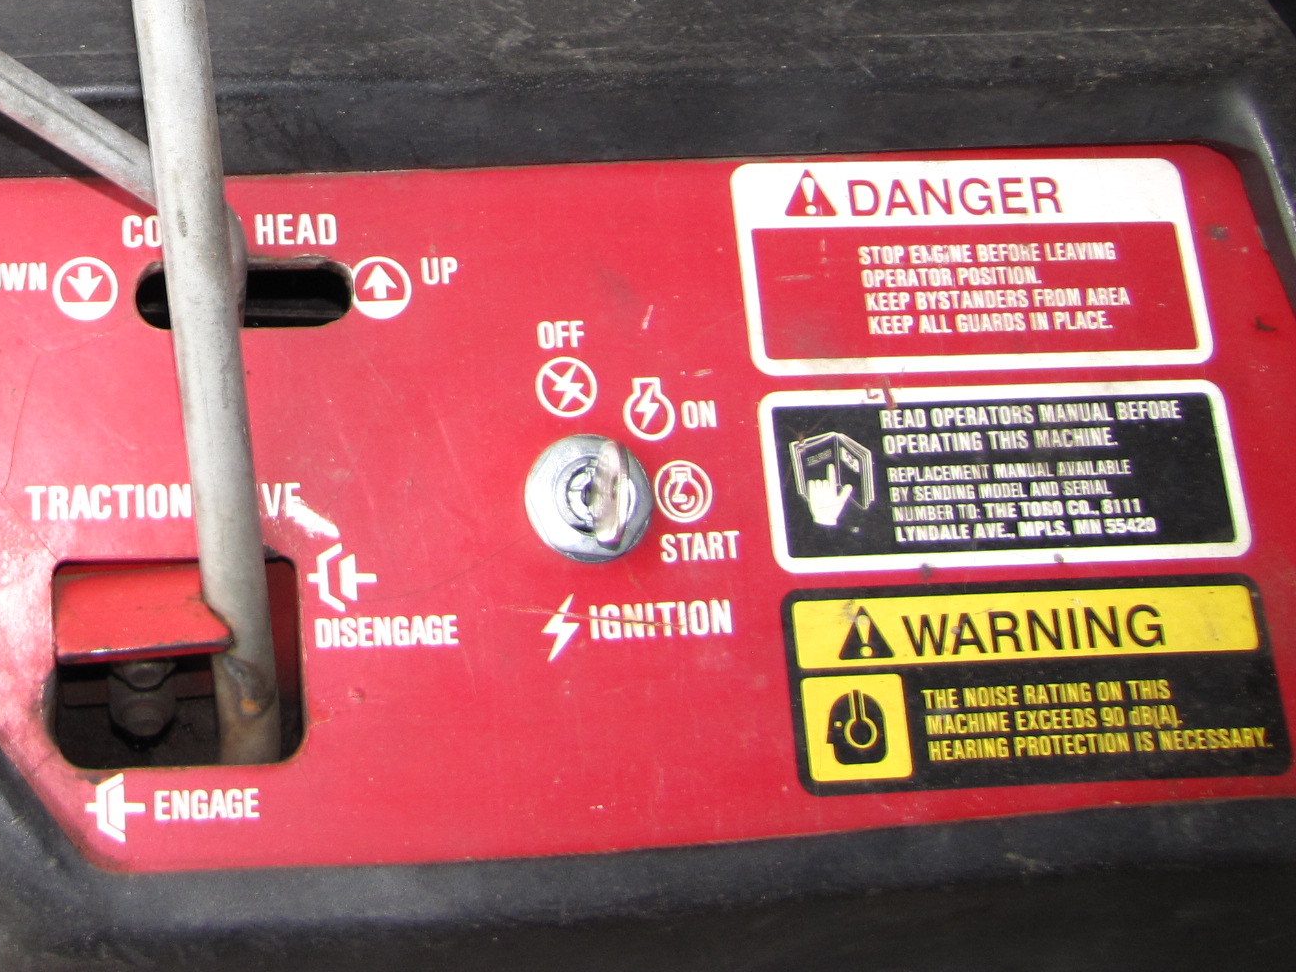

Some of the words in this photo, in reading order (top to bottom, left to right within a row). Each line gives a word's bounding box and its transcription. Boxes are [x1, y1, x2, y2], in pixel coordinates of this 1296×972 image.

[847, 176, 1064, 217] DANGER
[255, 213, 338, 245] HEAD
[857, 245, 904, 265] STOP
[908, 244, 973, 264] ENGINE
[976, 243, 1042, 263] BEFORE
[1044, 241, 1117, 261] LEAVING
[420, 256, 458, 286] UP
[861, 268, 953, 288] OPERATOR
[955, 266, 1042, 286] POSITION.
[864, 291, 910, 311] KEEP
[914, 289, 1029, 310] BYSTANDERS
[1032, 287, 1082, 307] FROM
[1085, 286, 1130, 306] AREA
[536, 320, 585, 349] OFF
[867, 315, 913, 335] KEEP
[918, 314, 953, 333] ALL
[955, 312, 1026, 332] GUARDS
[1028, 311, 1049, 331] IN
[1052, 310, 1113, 330] PLACE.
[680, 400, 717, 429] ON
[879, 408, 927, 429] READ
[930, 405, 1034, 427] OPERATORS
[1037, 402, 1114, 423] MANUAL
[1114, 400, 1182, 421] BEFORE
[882, 432, 983, 454] OPERATING
[985, 430, 1029, 450] THIS
[1032, 427, 1119, 449] MACHINE.
[886, 464, 990, 483] REPLACEMENT
[992, 462, 1054, 480] MANUAL
[1056, 459, 1131, 477] AVAILABLE
[25, 483, 192, 520] TRACTION
[889, 486, 910, 503] BY
[912, 484, 976, 502] SENDING
[978, 482, 1028, 500] MODEL
[1029, 481, 1060, 498] AND
[1062, 479, 1113, 497] SERIAL
[892, 504, 954, 523] NUMBER
[956, 503, 982, 520] TO:
[982, 501, 1018, 519] THE
[1018, 499, 1064, 518] TORO
[1100, 497, 1142, 515] 8111
[894, 524, 971, 543] LYNDALE
[1072, 518, 1103, 536] MN
[1104, 516, 1157, 535] 55420
[660, 530, 740, 563] START
[315, 614, 459, 649] DISENGAGE
[588, 599, 734, 640] IGNITION
[902, 604, 1166, 657] WARNING
[920, 688, 959, 709] THE
[962, 685, 1020, 708] NOISE
[1022, 682, 1092, 705] RATING
[1095, 681, 1123, 702] ON
[1125, 679, 1171, 700] THIS
[924, 711, 1011, 735] MACHINE
[1014, 708, 1098, 731] EXCEEDS
[1100, 706, 1125, 727] 90
[927, 737, 1010, 762] HEARING
[1013, 732, 1130, 758] PROTECTION
[1133, 731, 1154, 752] IS
[1157, 727, 1275, 751] NECESSARY.
[154, 788, 260, 821] ENGAGE
